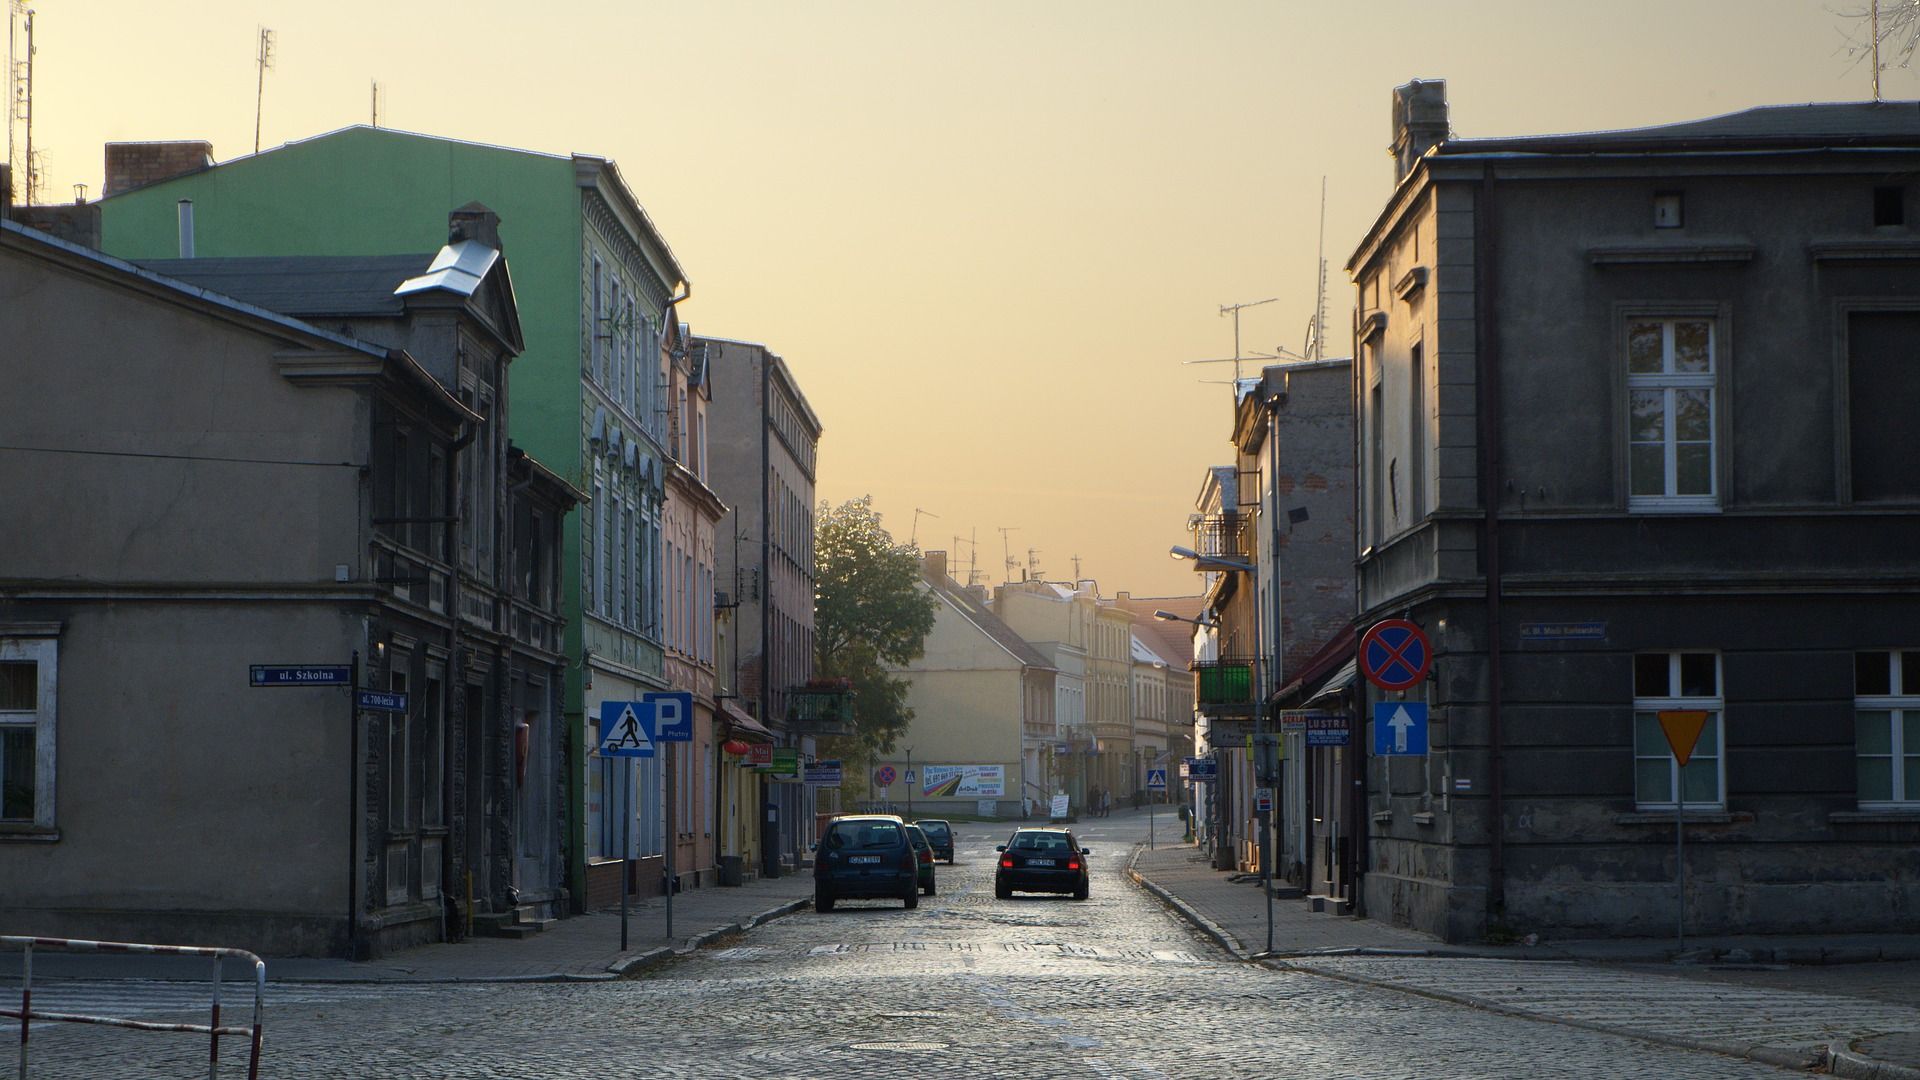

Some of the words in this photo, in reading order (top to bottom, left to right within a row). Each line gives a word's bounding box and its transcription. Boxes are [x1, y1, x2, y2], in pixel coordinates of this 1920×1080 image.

[279, 671, 292, 680] ul.
[296, 670, 334, 680] Szkolna
[655, 698, 682, 736] P
[1308, 719, 1348, 728] LUSTRA
